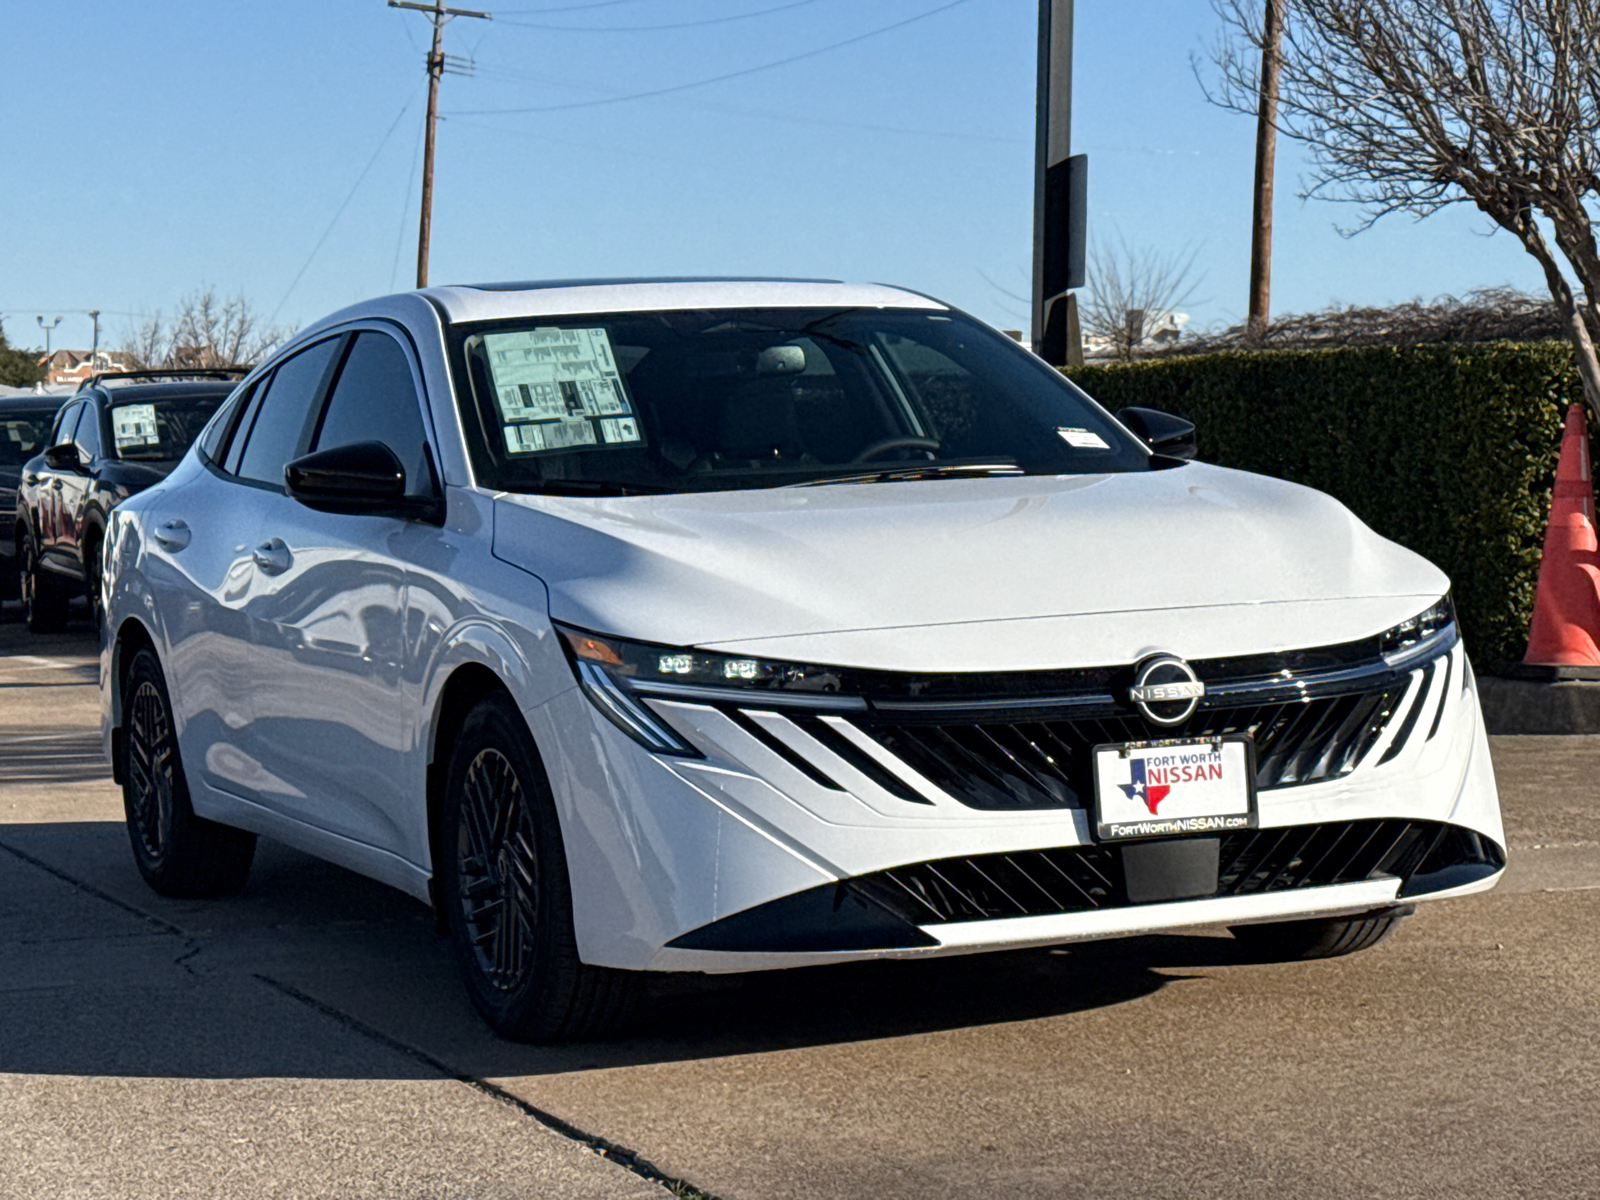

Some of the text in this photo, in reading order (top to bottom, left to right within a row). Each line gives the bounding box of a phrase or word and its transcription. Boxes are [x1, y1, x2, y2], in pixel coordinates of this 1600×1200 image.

[1130, 684, 1203, 701] NISSAN
[1124, 736, 1222, 749] FORT WORTH TEXAS
[1146, 753, 1222, 767] FORT WORTH
[1147, 763, 1223, 785] NISSAN
